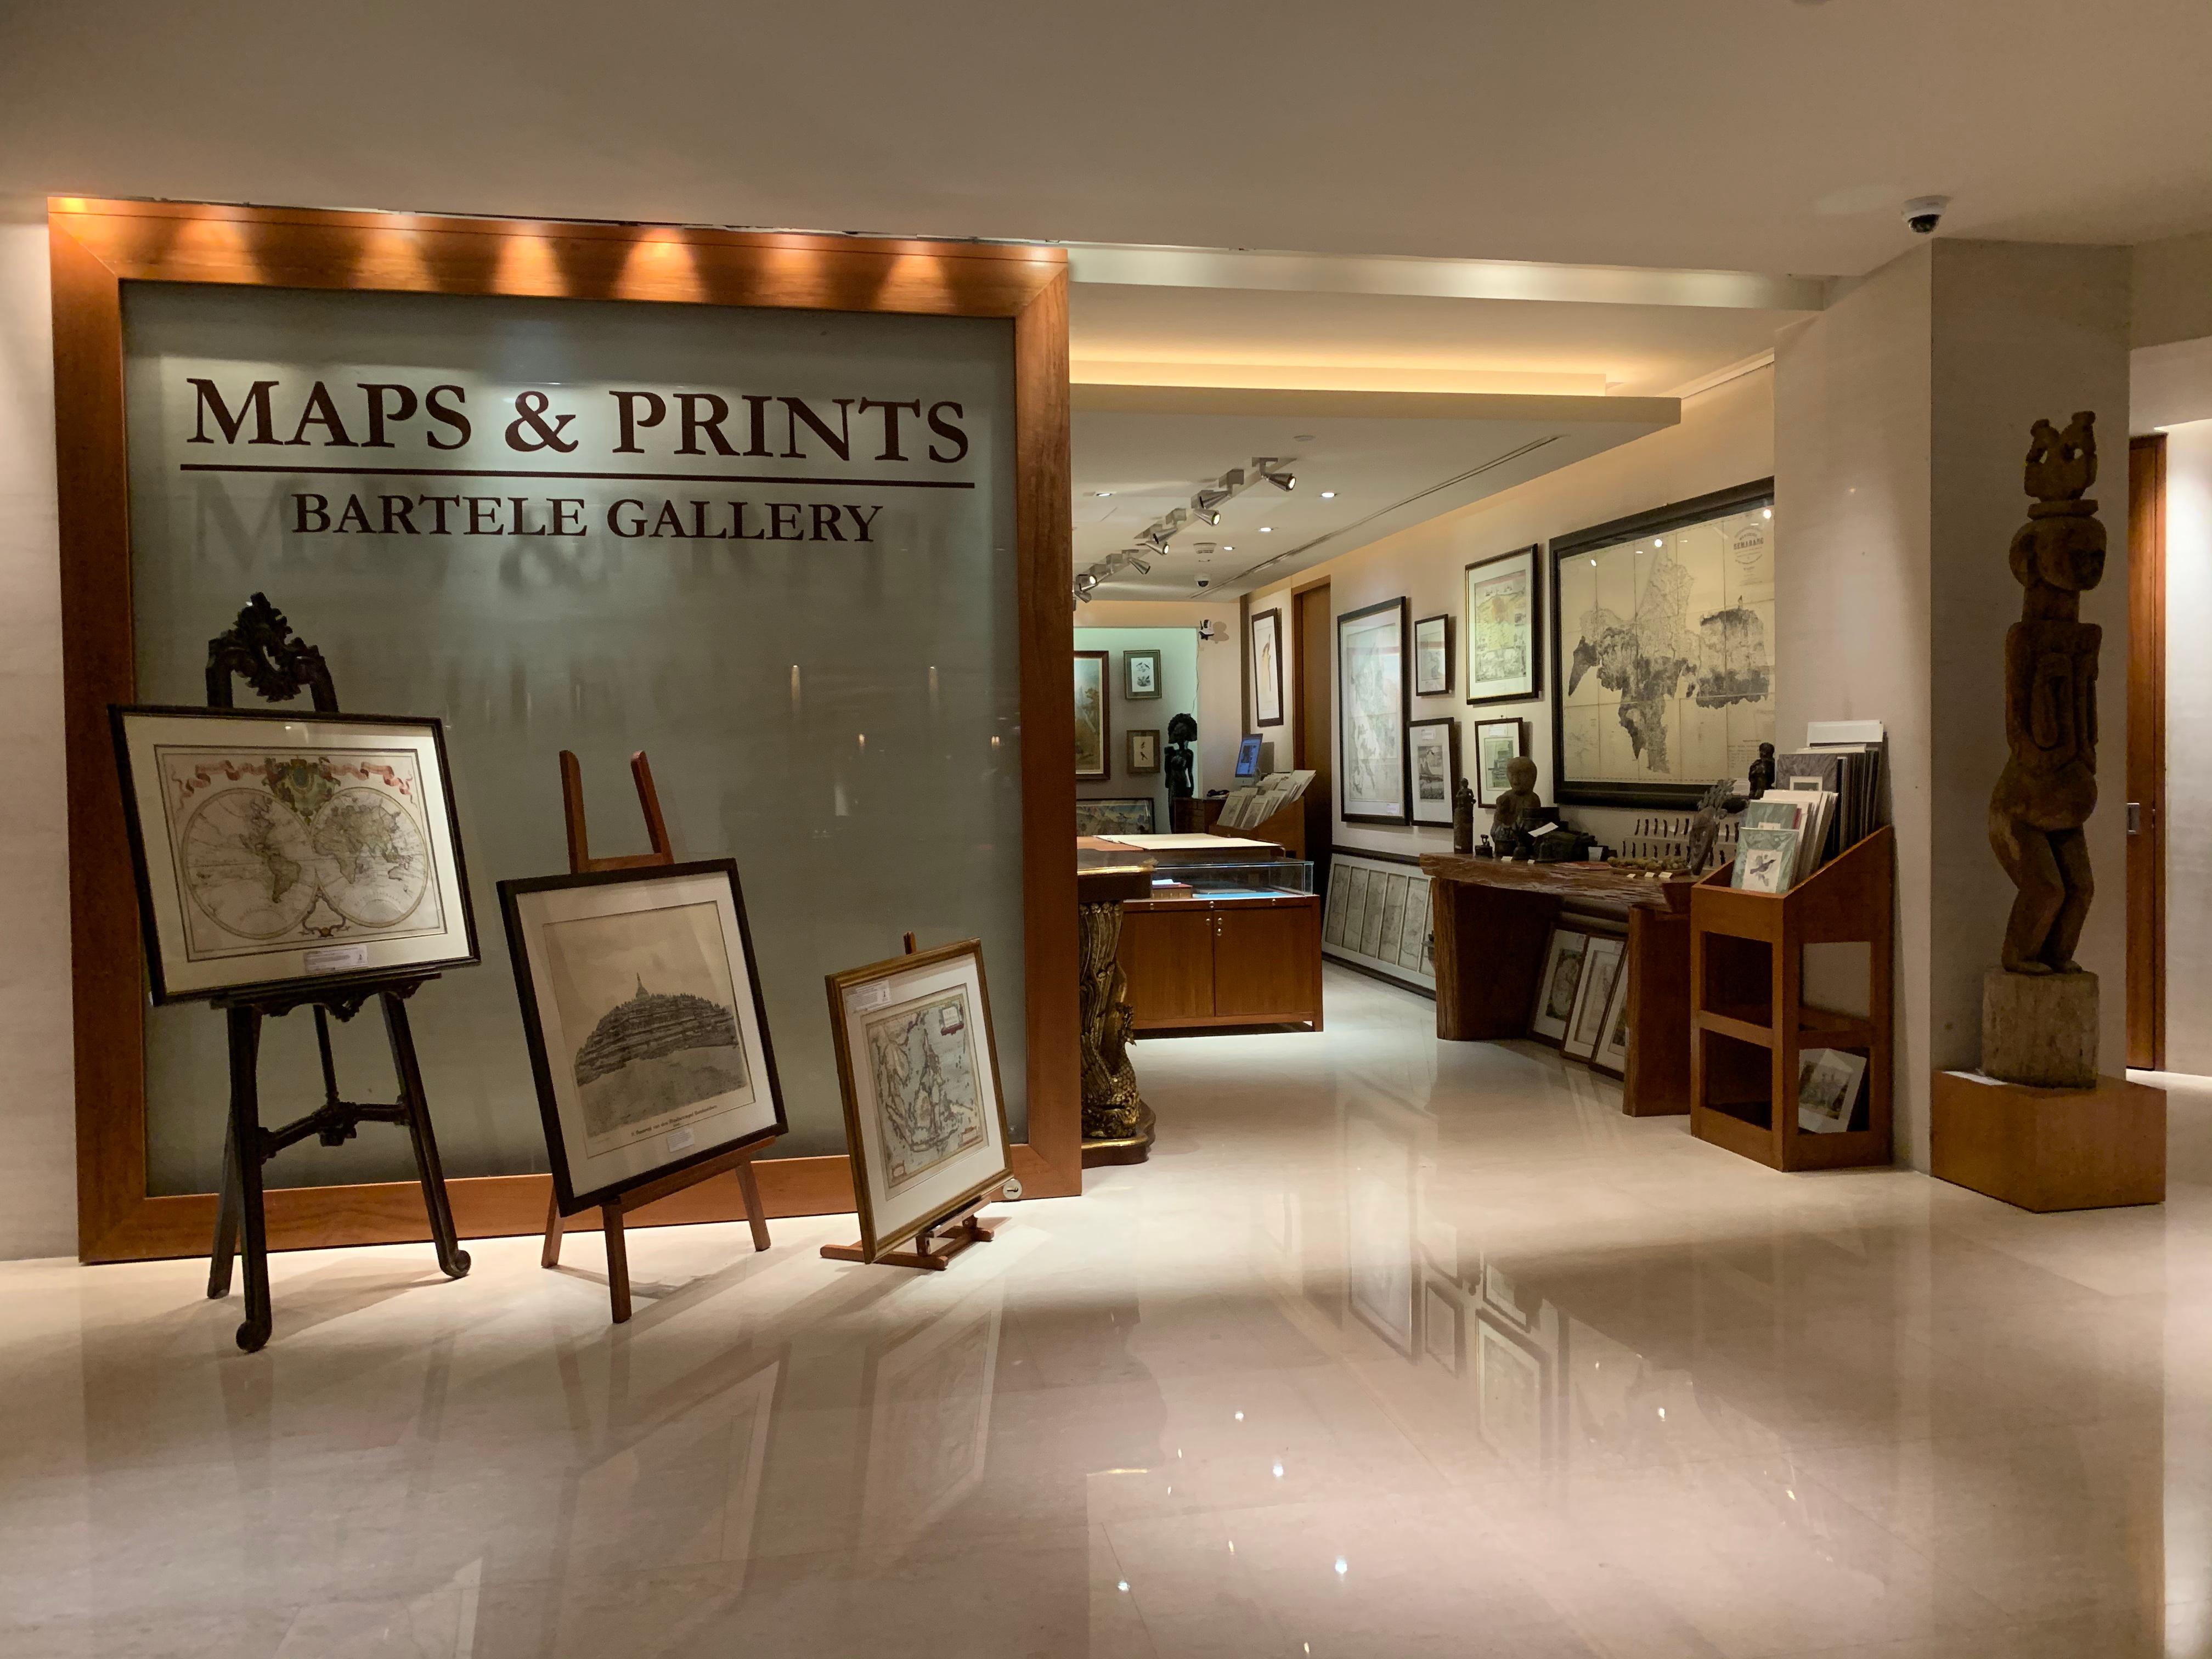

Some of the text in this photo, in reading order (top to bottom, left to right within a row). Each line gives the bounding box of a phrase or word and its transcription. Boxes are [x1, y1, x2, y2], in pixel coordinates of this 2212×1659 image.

[187, 378, 969, 464] MAPS & PRINTS
[291, 493, 883, 543] BARTELE GALLERY
